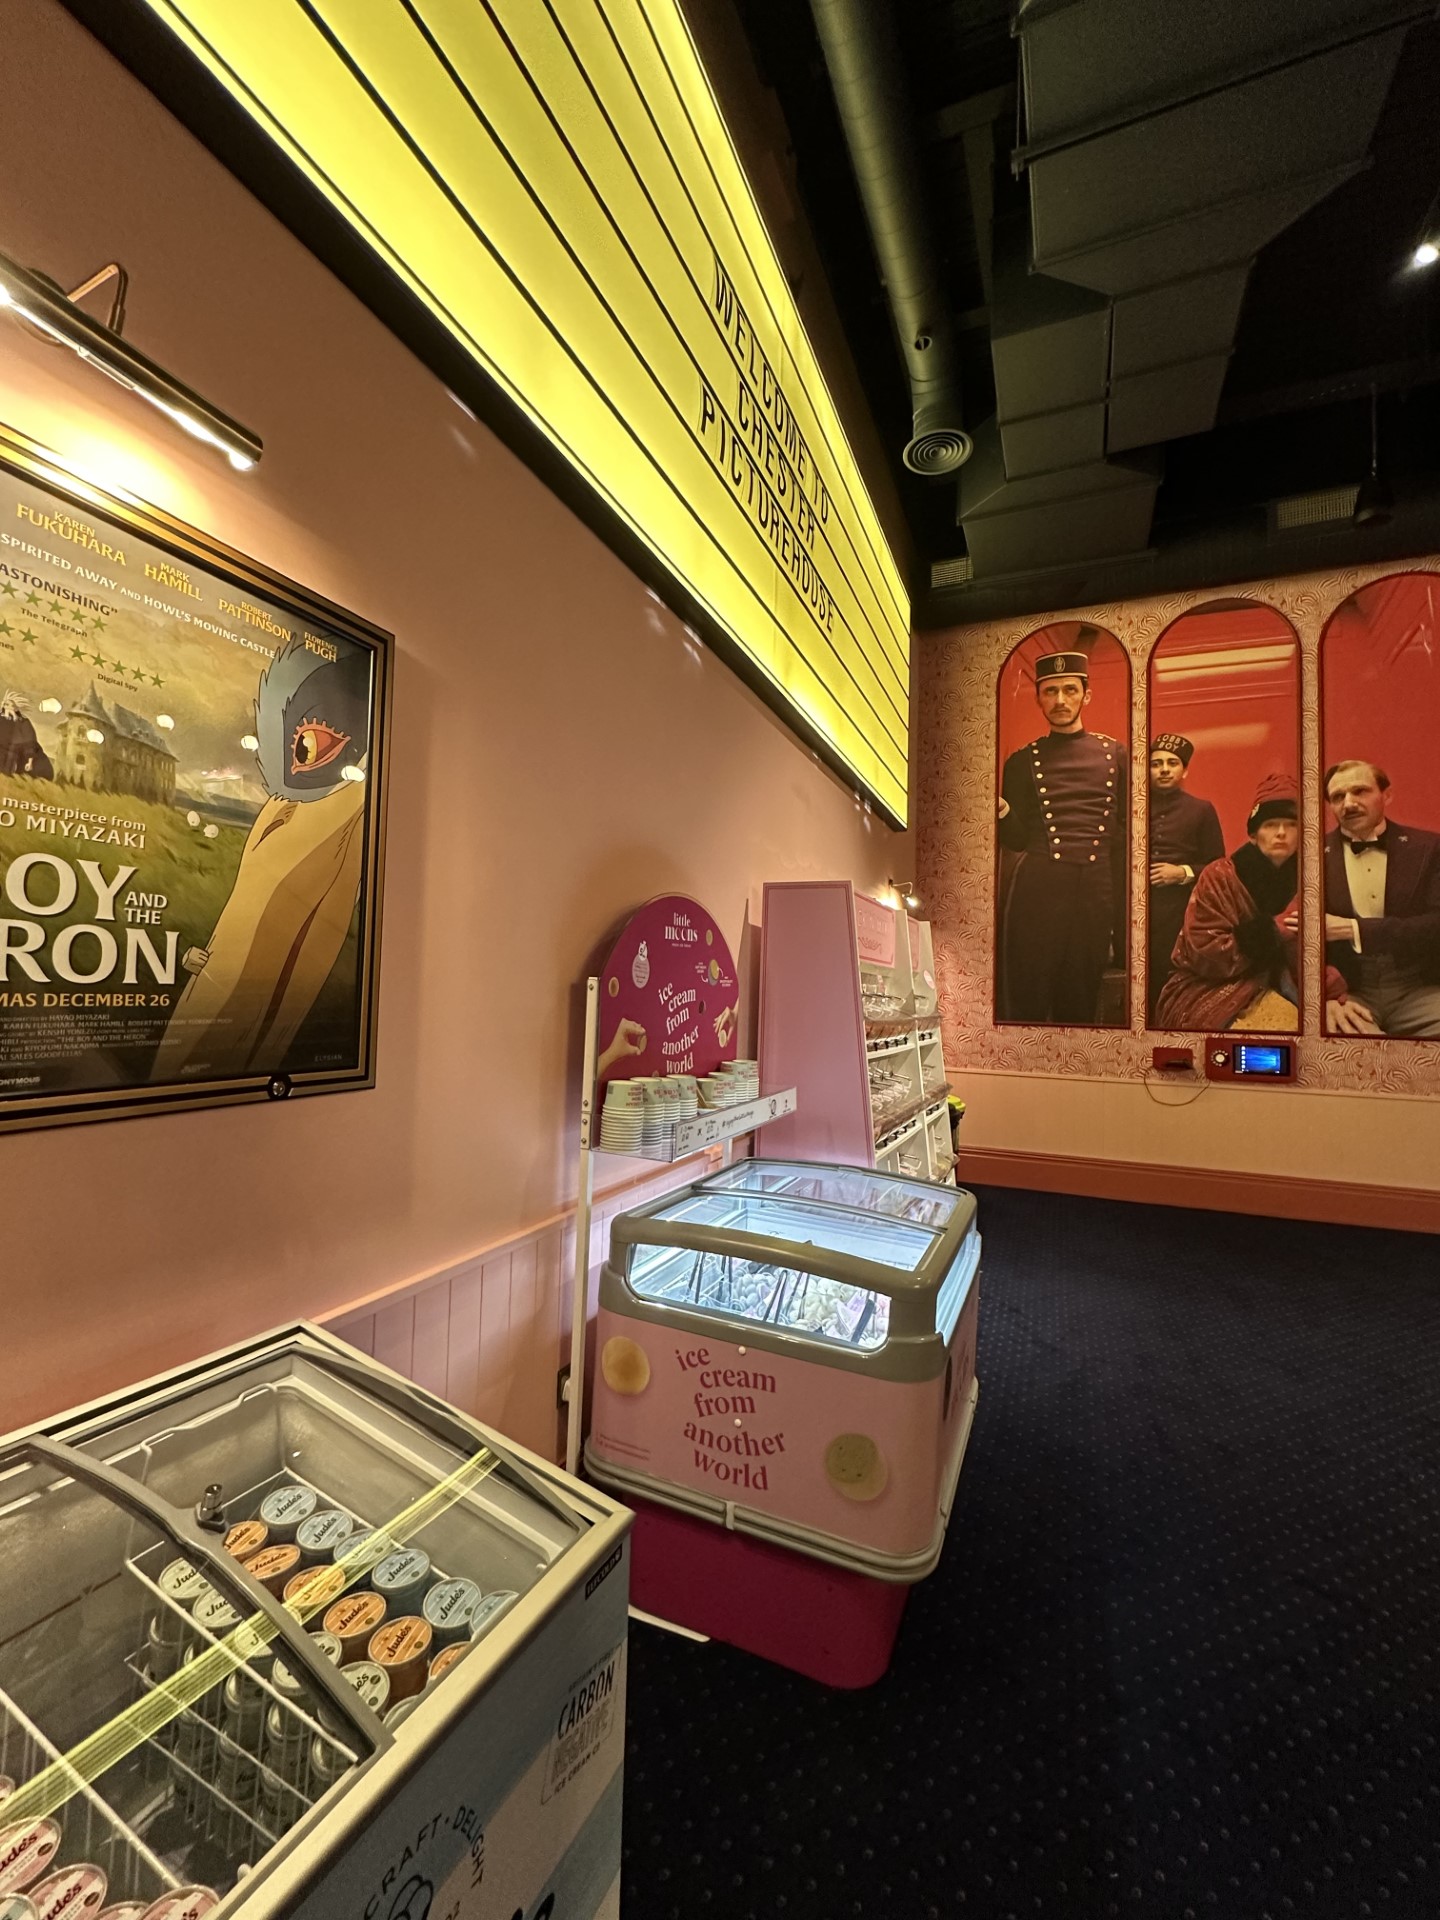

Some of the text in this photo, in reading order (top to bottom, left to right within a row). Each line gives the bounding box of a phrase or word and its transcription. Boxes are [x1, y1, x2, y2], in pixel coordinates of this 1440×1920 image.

[713, 257, 829, 524] WELCOME TO
[738, 380, 815, 550] CHESTER
[700, 384, 833, 633] PICTUREHOUSE
[16, 503, 127, 567] FUKUHARA
[54, 511, 96, 538] KAREN
[144, 563, 204, 602] HAMILL
[160, 562, 190, 583] MARK
[0, 533, 72, 570] SPIRITED
[75, 566, 118, 591] AWAY
[144, 595, 192, 623] HOWL'S
[193, 617, 238, 643] MOVING
[240, 637, 276, 659] CASTLE
[20, 607, 88, 638] The Telegraph
[218, 598, 292, 642] PATTINSON
[241, 601, 273, 621] ROBERT
[304, 632, 338, 652] FLORENCE
[305, 640, 337, 663] PUGH
[97, 673, 139, 693] Digital Spy
[1156, 734, 1187, 748] LOBBY
[1158, 741, 1179, 752] BOY
[2, 797, 146, 832] masterpiece from
[26, 814, 147, 850] MIYAZAKI
[125, 890, 168, 910] AND
[124, 906, 161, 925] THE
[673, 912, 691, 928] little
[664, 926, 699, 942] moons
[43, 993, 146, 1008] DECEMBER
[150, 994, 171, 1007] 26
[658, 982, 674, 1006] ice
[668, 988, 697, 1013] cream
[3, 1022, 31, 1030] KAREN
[33, 1021, 75, 1029] FUKUHARA
[75, 1013, 110, 1021] MIYAZAKI
[665, 1007, 690, 1036] from
[37, 1029, 65, 1037] KENSHI
[109, 1033, 121, 1041] THE
[661, 1025, 699, 1056] another
[10, 1051, 33, 1060] SALES
[34, 1050, 82, 1059] GOODFELLAS
[24, 1043, 62, 1052] KIYOFUMI
[63, 1042, 99, 1050] NAKAJIMA
[666, 1051, 694, 1074] world
[675, 1347, 711, 1372] ice
[700, 1368, 777, 1394] cream
[694, 1392, 757, 1418] from
[683, 1421, 786, 1457] another
[693, 1448, 769, 1491] world
[275, 1492, 303, 1518] Jude's
[223, 1526, 251, 1550] Jude's
[313, 1516, 338, 1543] Jude's
[250, 1551, 288, 1573] Jude's
[387, 1555, 416, 1582] Jude's
[338, 1598, 370, 1631] Jude's
[440, 1585, 466, 1621] Jude's
[387, 1624, 412, 1658] Jude's
[557, 1660, 616, 1740] CARBON
[567, 1753, 591, 1782] CREAM
[363, 1805, 485, 1920] CRAFT DELIGHT
